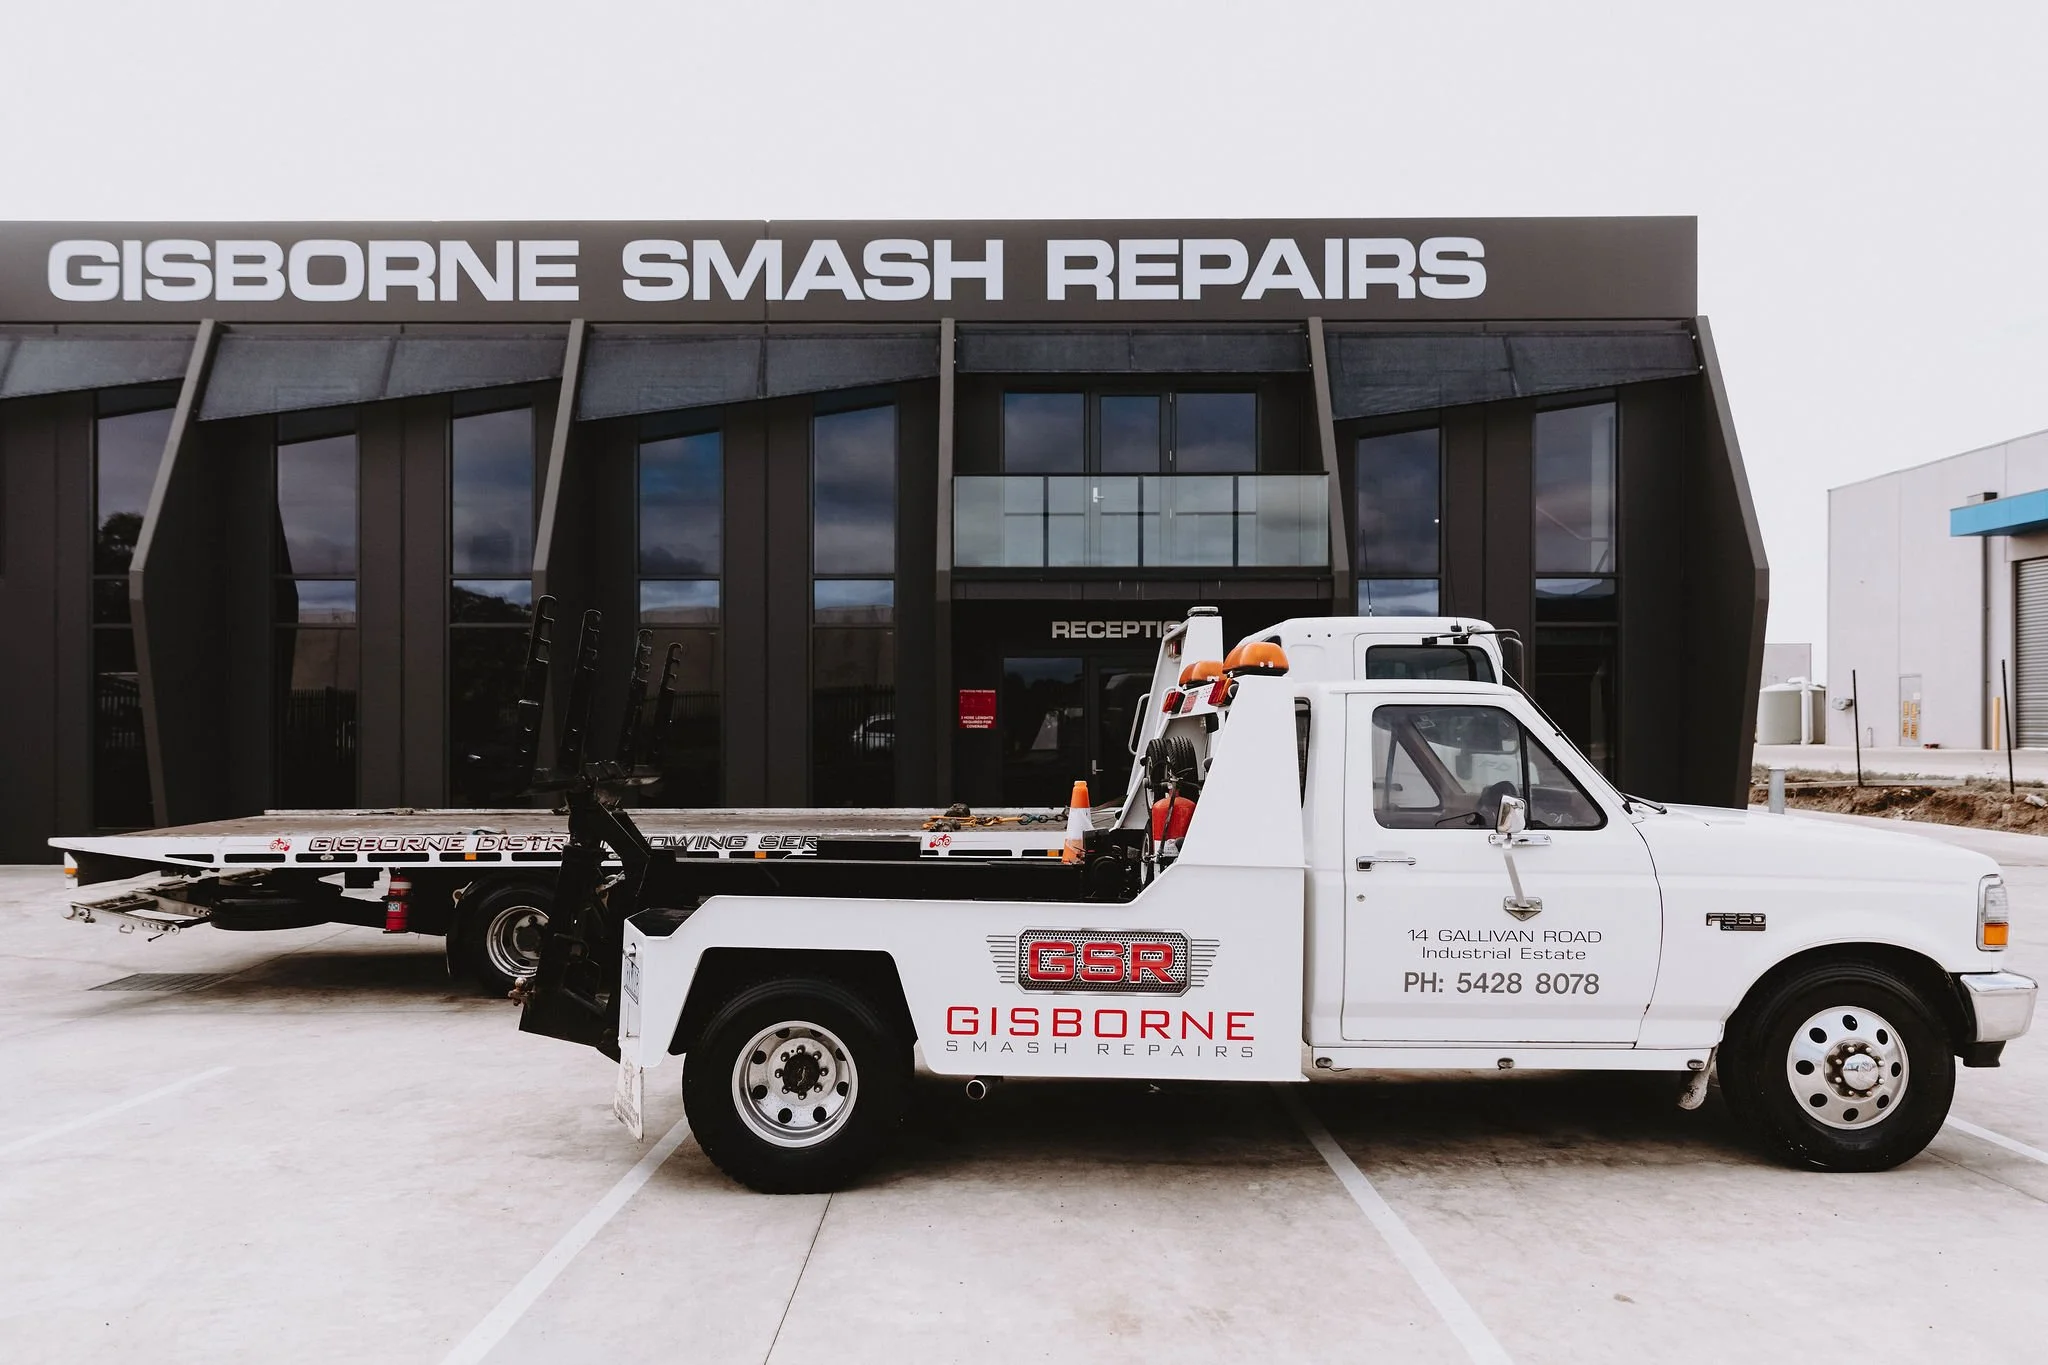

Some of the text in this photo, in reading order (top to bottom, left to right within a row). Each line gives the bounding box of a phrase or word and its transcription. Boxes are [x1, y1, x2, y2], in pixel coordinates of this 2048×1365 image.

[47, 237, 1487, 302] GISBORNE SMASH REPAIRS
[1051, 620, 1181, 639] RECEPTI
[308, 834, 818, 852] GISBORNE DISTR OWING SER
[1407, 929, 1602, 943] 14 GALLIVAN ROAD
[1027, 940, 1178, 984] GSR
[1422, 946, 1586, 960] Industrial Estate
[1403, 971, 1600, 995] PH: 5428 8078
[946, 1005, 1255, 1041] GISBORNE
[945, 1040, 1254, 1058] SMASH REPAIRS
